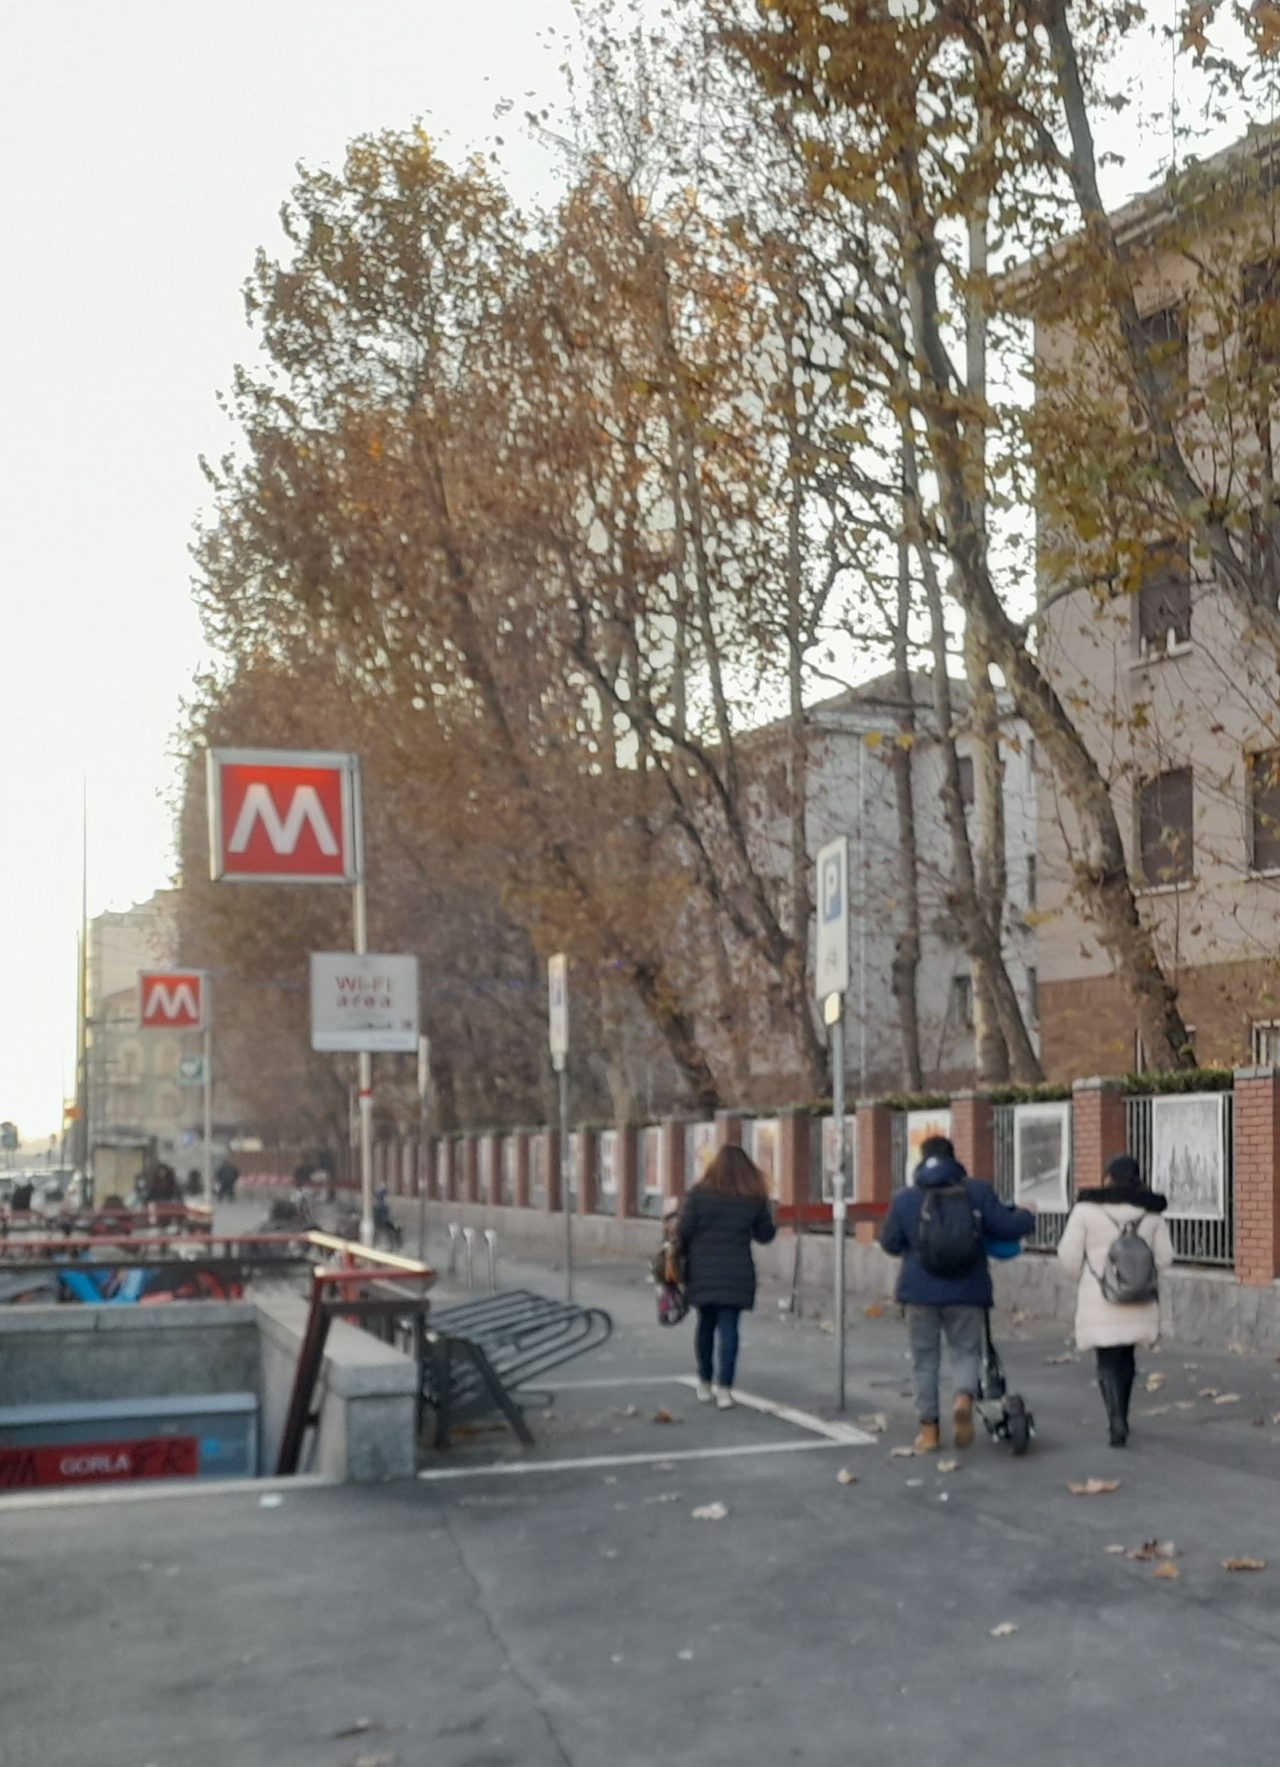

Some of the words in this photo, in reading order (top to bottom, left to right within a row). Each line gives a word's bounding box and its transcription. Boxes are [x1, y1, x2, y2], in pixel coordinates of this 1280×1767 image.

[228, 782, 340, 856] M
[825, 863, 838, 917] P
[143, 982, 198, 1019] M
[336, 995, 391, 1008] area
[60, 1453, 130, 1476] GORLA
